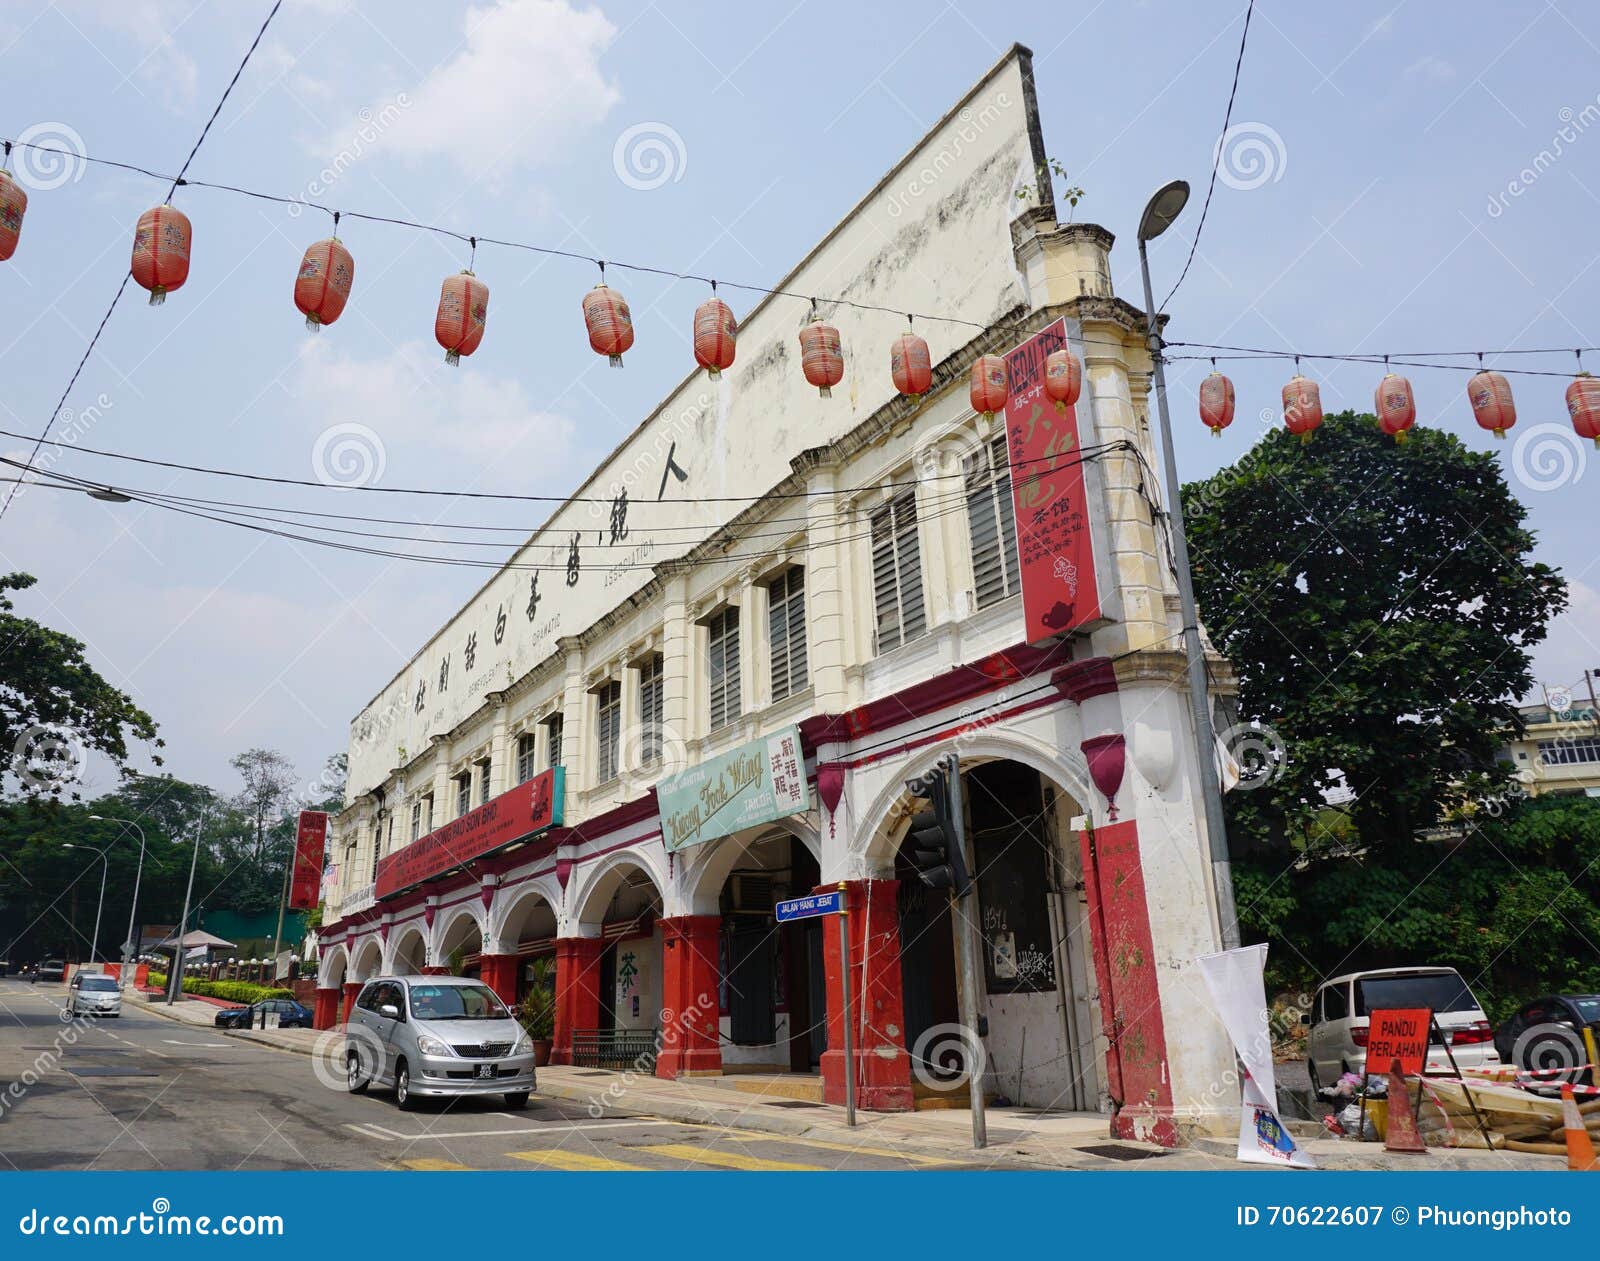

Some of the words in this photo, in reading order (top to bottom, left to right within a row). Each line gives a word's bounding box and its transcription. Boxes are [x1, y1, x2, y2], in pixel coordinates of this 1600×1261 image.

[727, 750, 764, 789] Wing
[781, 902, 798, 914] JALAN
[800, 899, 814, 911] HANG
[817, 896, 832, 908] JEBAT
[619, 951, 639, 989] 茶
[1381, 1020, 1417, 1038] PANDU
[1369, 1041, 1424, 1058] PERLAHAN
